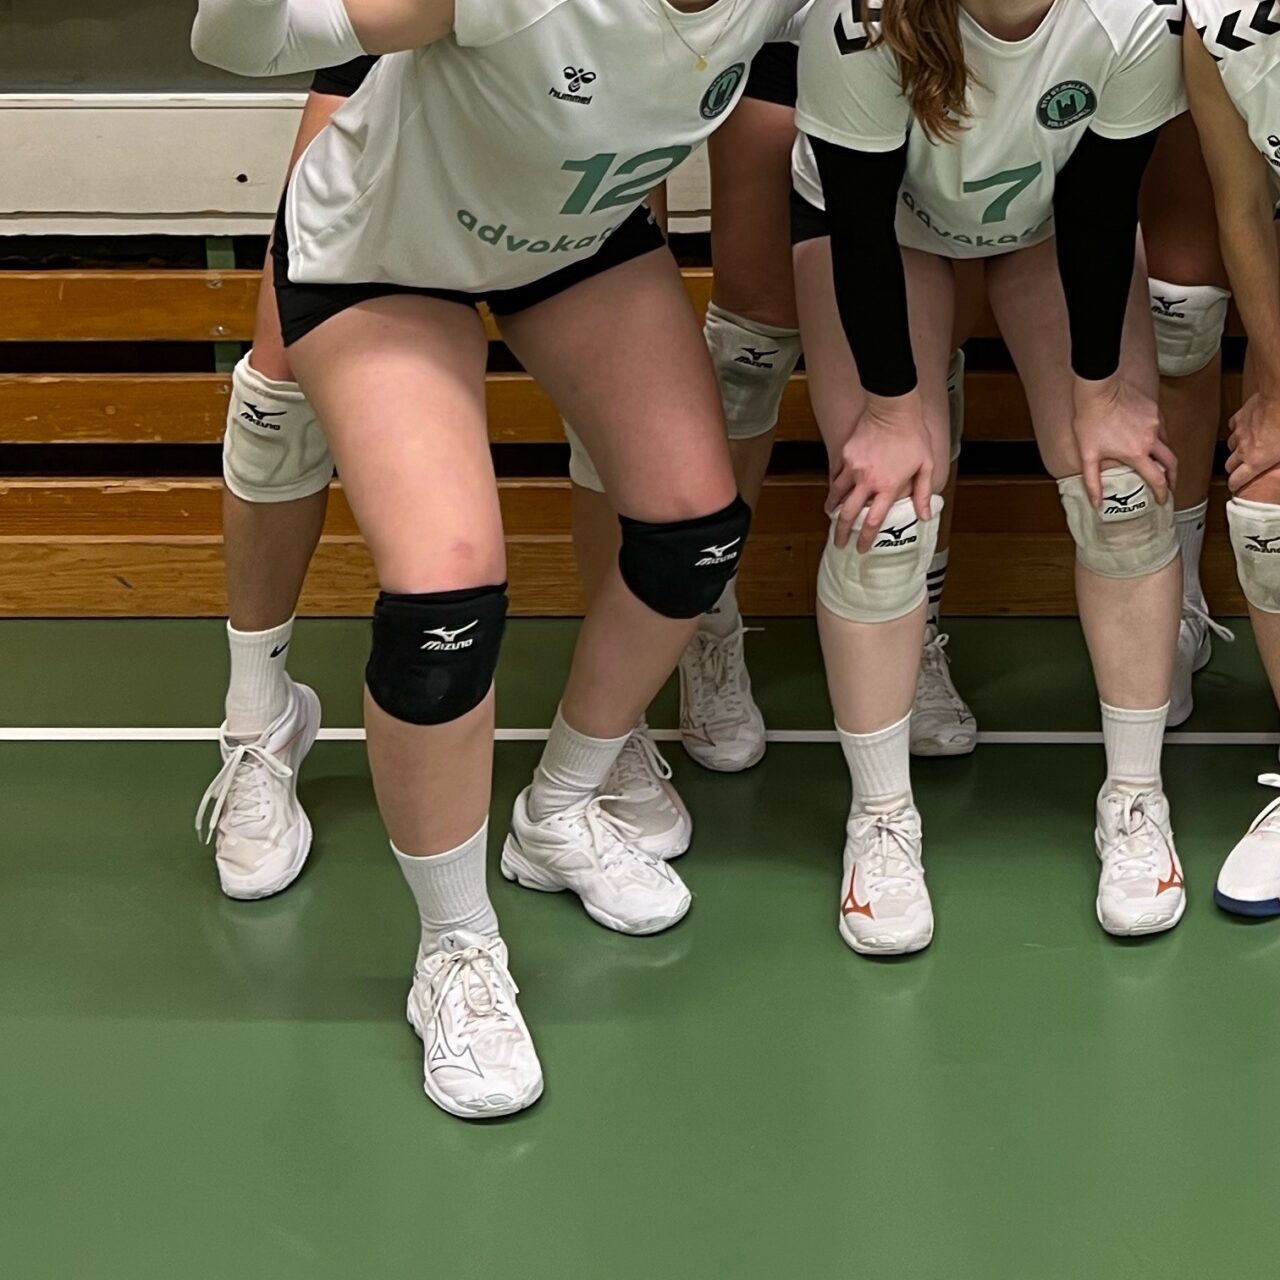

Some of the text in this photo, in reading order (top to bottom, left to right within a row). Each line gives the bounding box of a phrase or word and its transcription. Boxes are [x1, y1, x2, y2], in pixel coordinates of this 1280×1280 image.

[548, 87, 592, 105] hummel
[559, 144, 692, 215] 12
[962, 160, 1042, 225] 7
